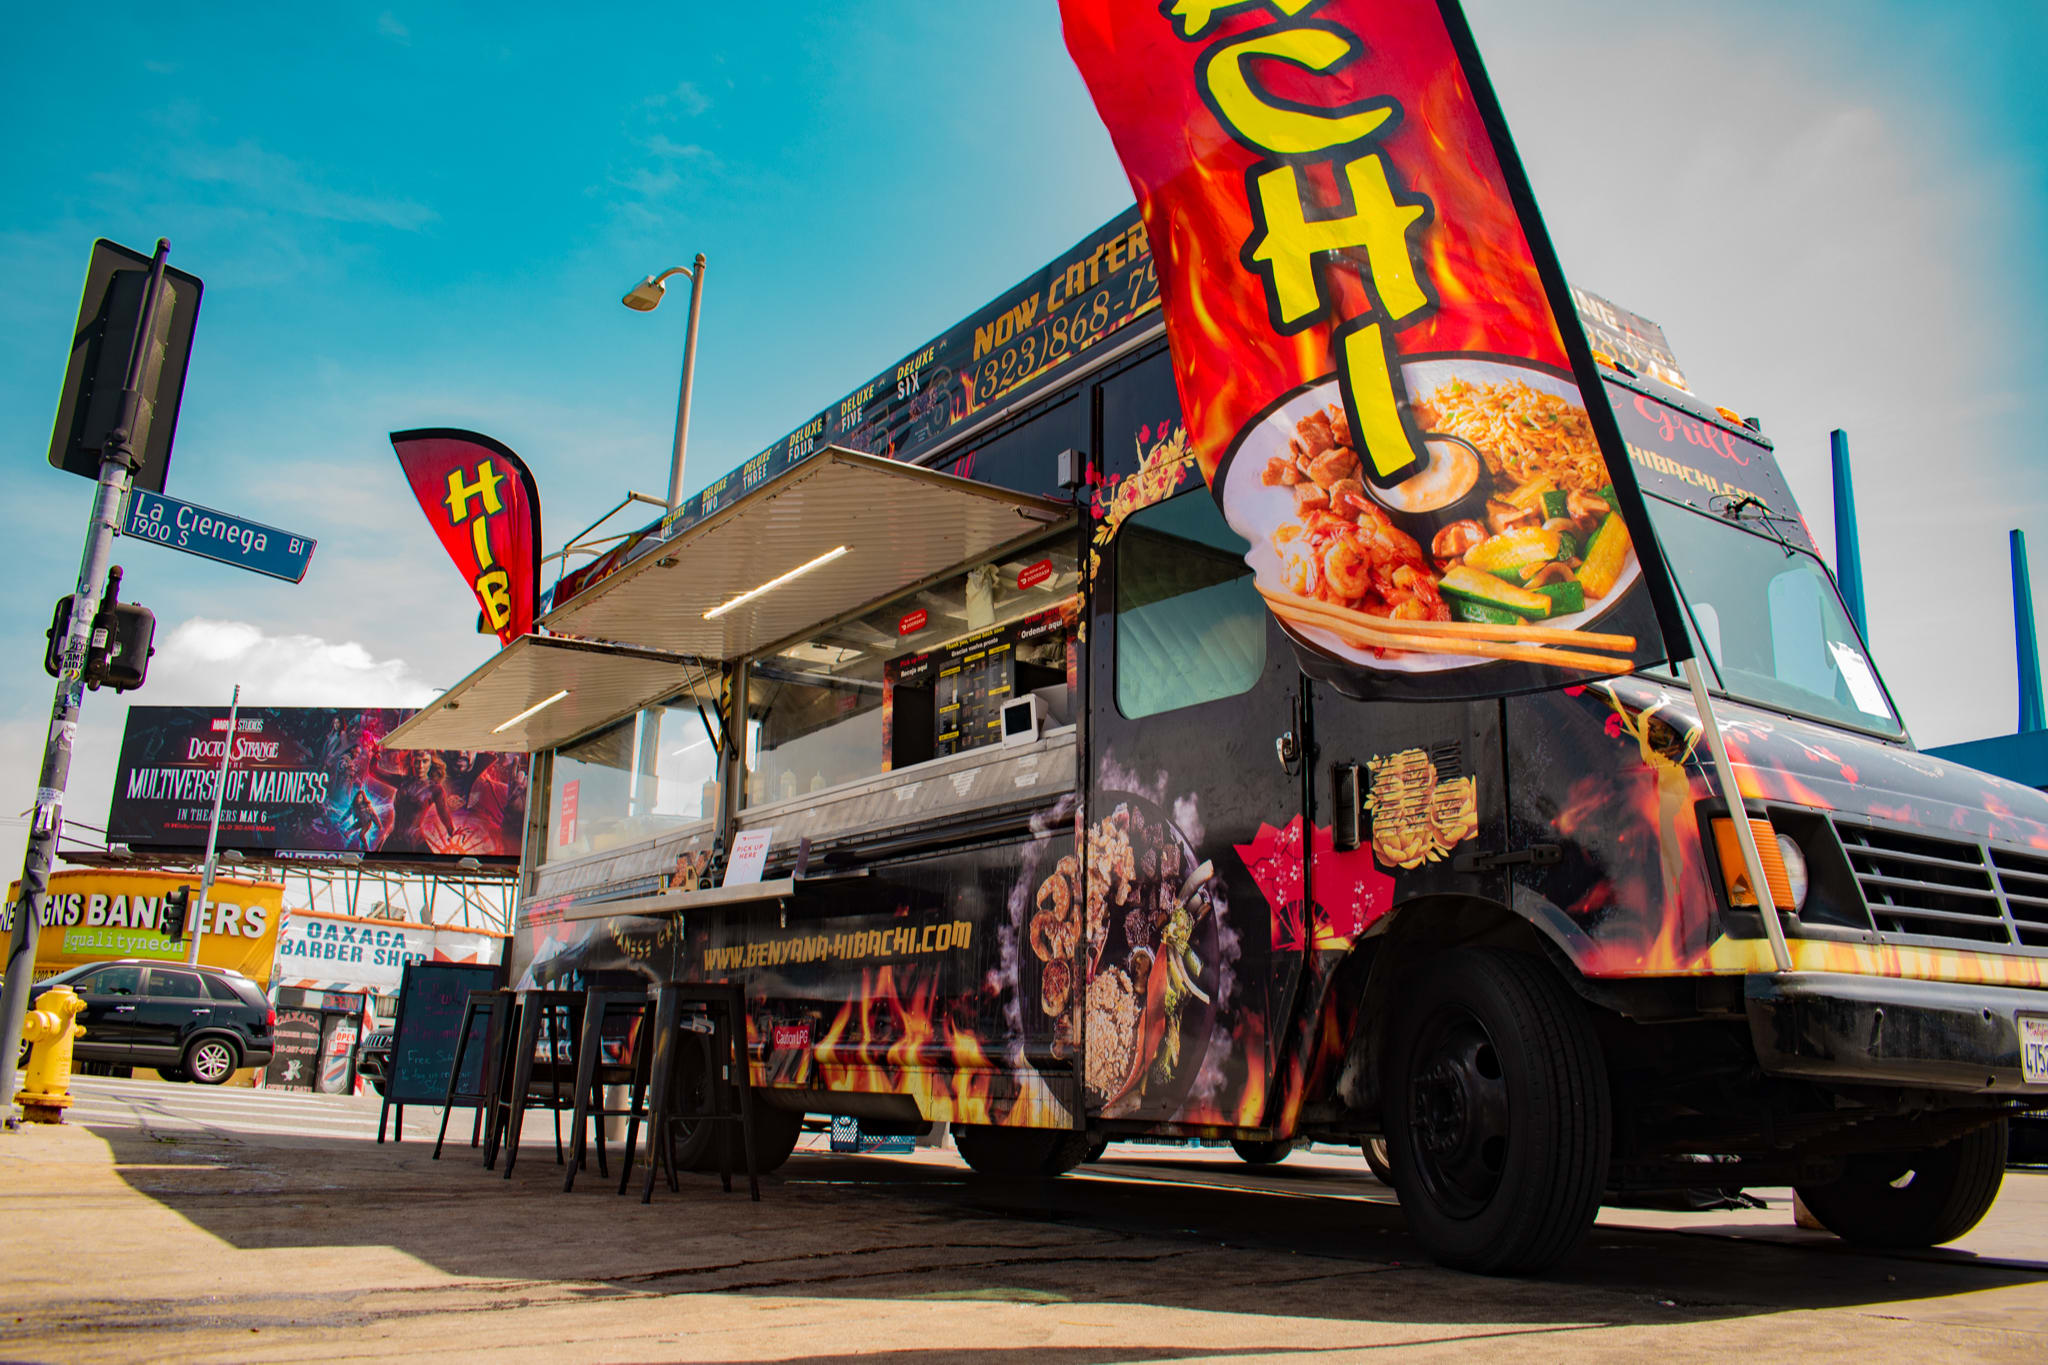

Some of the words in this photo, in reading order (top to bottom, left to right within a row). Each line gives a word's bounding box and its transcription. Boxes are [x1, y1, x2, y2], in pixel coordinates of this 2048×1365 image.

[1160, 0, 1428, 478] CHI
[973, 292, 1040, 361] NOW
[1047, 220, 1149, 313] CATER
[971, 258, 1160, 406] (323)868-79
[897, 346, 935, 381] DELUXE
[897, 371, 920, 400] SIX
[841, 384, 875, 417] DELUXE
[789, 419, 823, 447] DELUXE
[841, 407, 863, 433] FIVE
[1633, 394, 1749, 466] Grill
[743, 448, 772, 476] DELUXE
[787, 438, 814, 463] FOUR
[702, 477, 728, 503] DELUXE
[742, 464, 768, 490] THREE
[702, 496, 718, 516] TWO
[131, 517, 171, 541] 1900
[177, 530, 190, 546] S
[135, 493, 165, 522] La
[176, 505, 268, 554] Cienega
[660, 525, 673, 539] ONE
[443, 458, 505, 632] HIB
[1021, 624, 1047, 639] Ordenar
[187, 737, 226, 760] DOCTO
[230, 737, 280, 761] STRANGE
[226, 770, 248, 802] OF
[249, 771, 329, 804] MADNESS
[177, 808, 188, 821] IN
[190, 808, 238, 823] THEAERS
[239, 809, 260, 824] MAY
[260, 810, 268, 824] 6
[736, 845, 752, 853] PICK
[754, 843, 764, 851] UP
[739, 851, 757, 859] HERE
[41, 893, 82, 926] GNS
[87, 893, 267, 939] BANERS
[306, 921, 407, 949] OAXACA
[280, 938, 363, 963] BARBER
[322, 994, 359, 1009] OPEN
[274, 1011, 319, 1030] OAXACA
[336, 1032, 355, 1042] OPEN
[776, 1030, 795, 1045] Caution
[796, 1029, 808, 1045] LPG
[2024, 1043, 2048, 1072] 475
